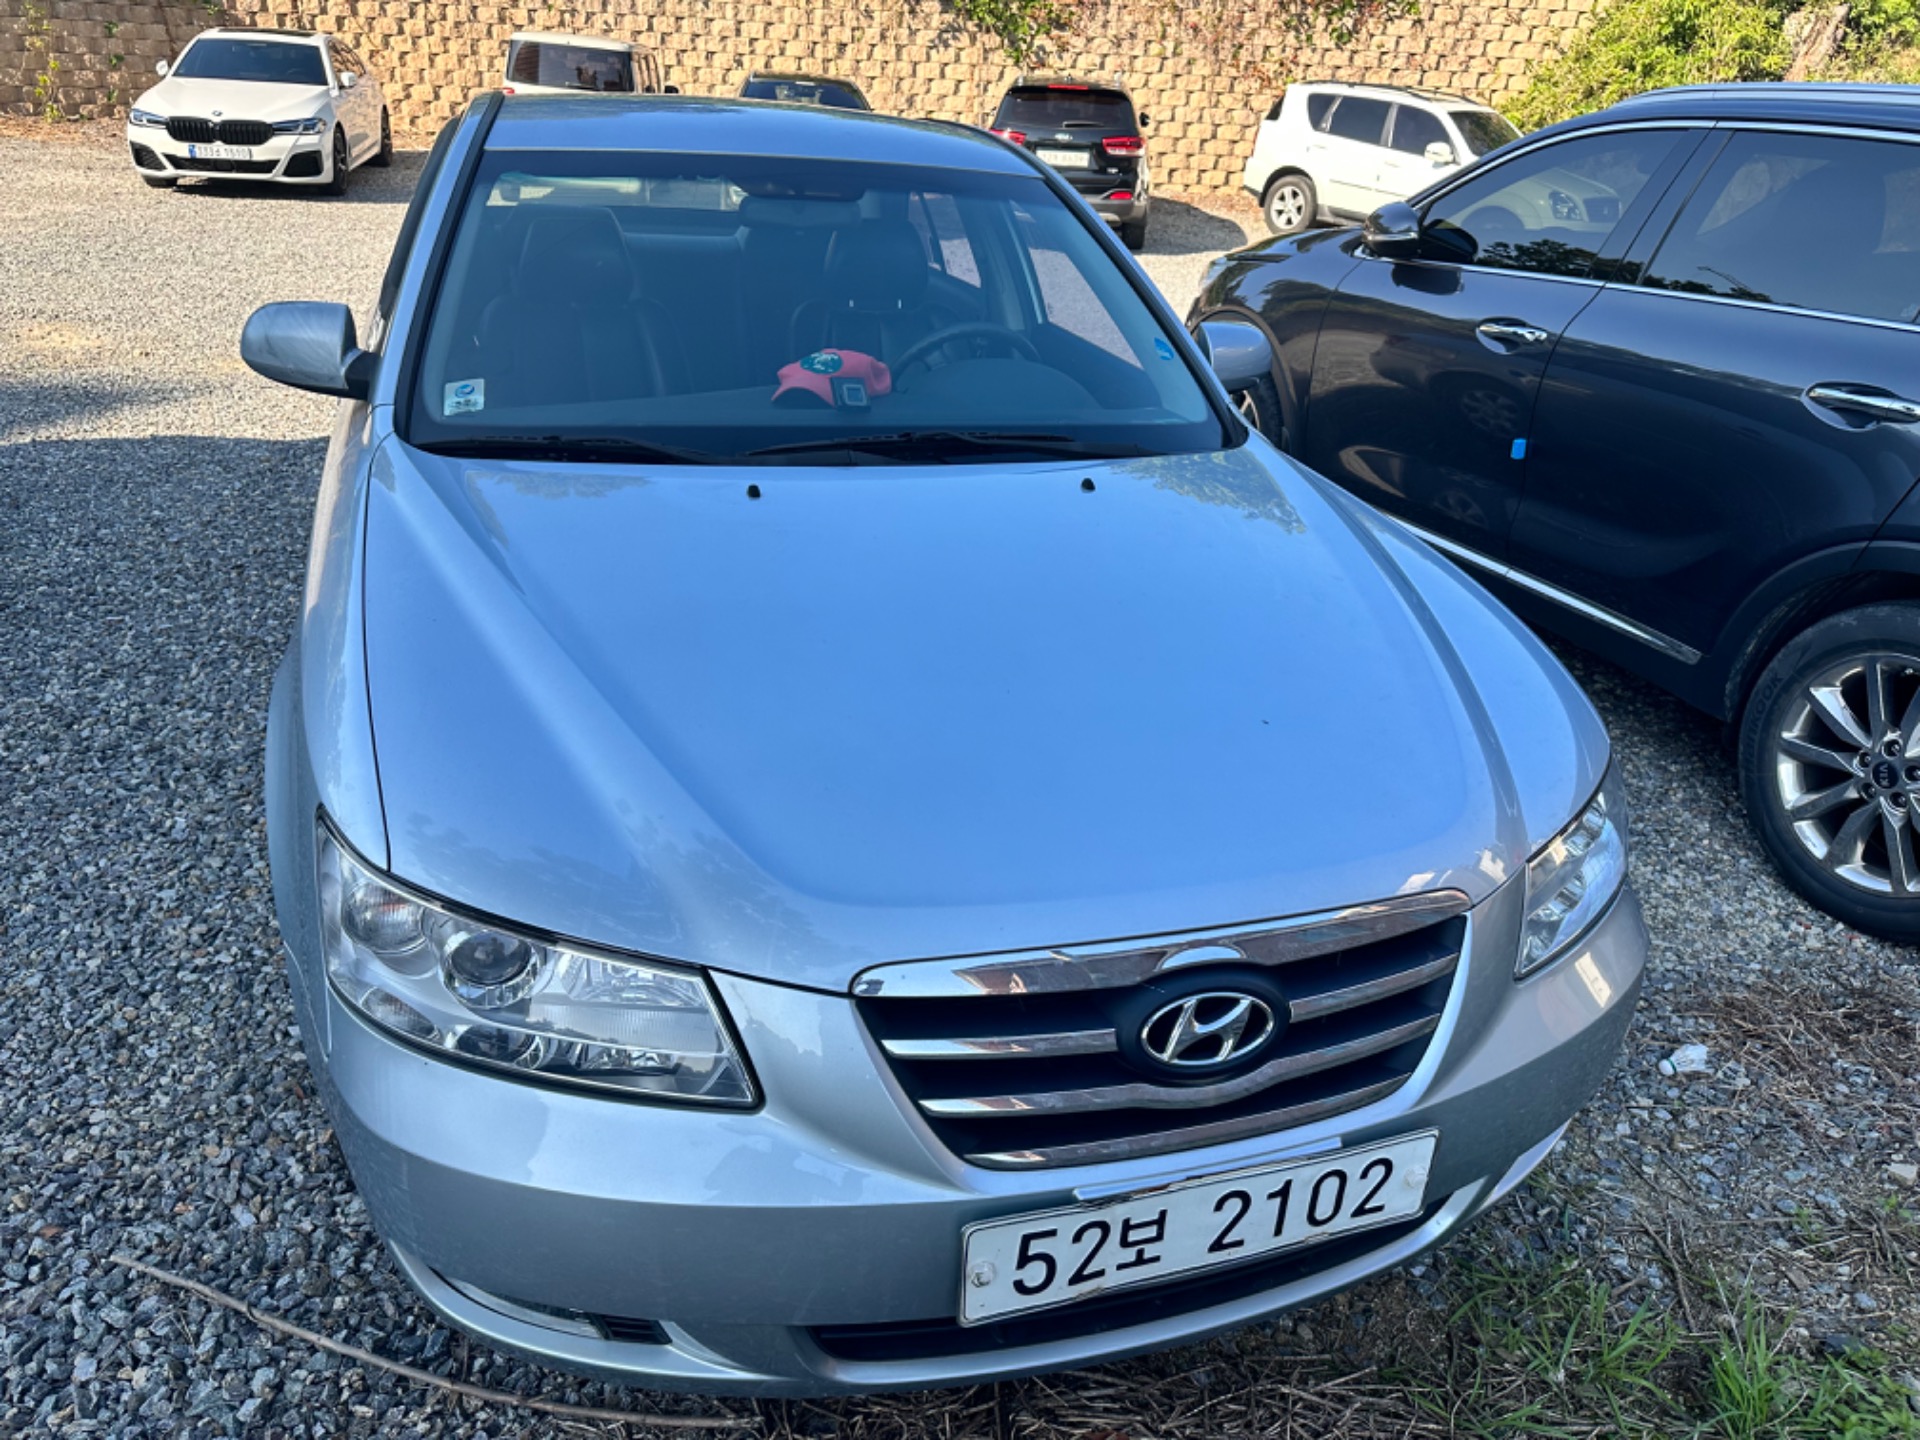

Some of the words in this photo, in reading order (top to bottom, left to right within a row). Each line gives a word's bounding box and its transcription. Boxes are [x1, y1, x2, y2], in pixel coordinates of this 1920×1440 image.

[1879, 763, 1890, 787] KIA
[1012, 1208, 1168, 1296] 52보
[1207, 1157, 1394, 1253] 2102
